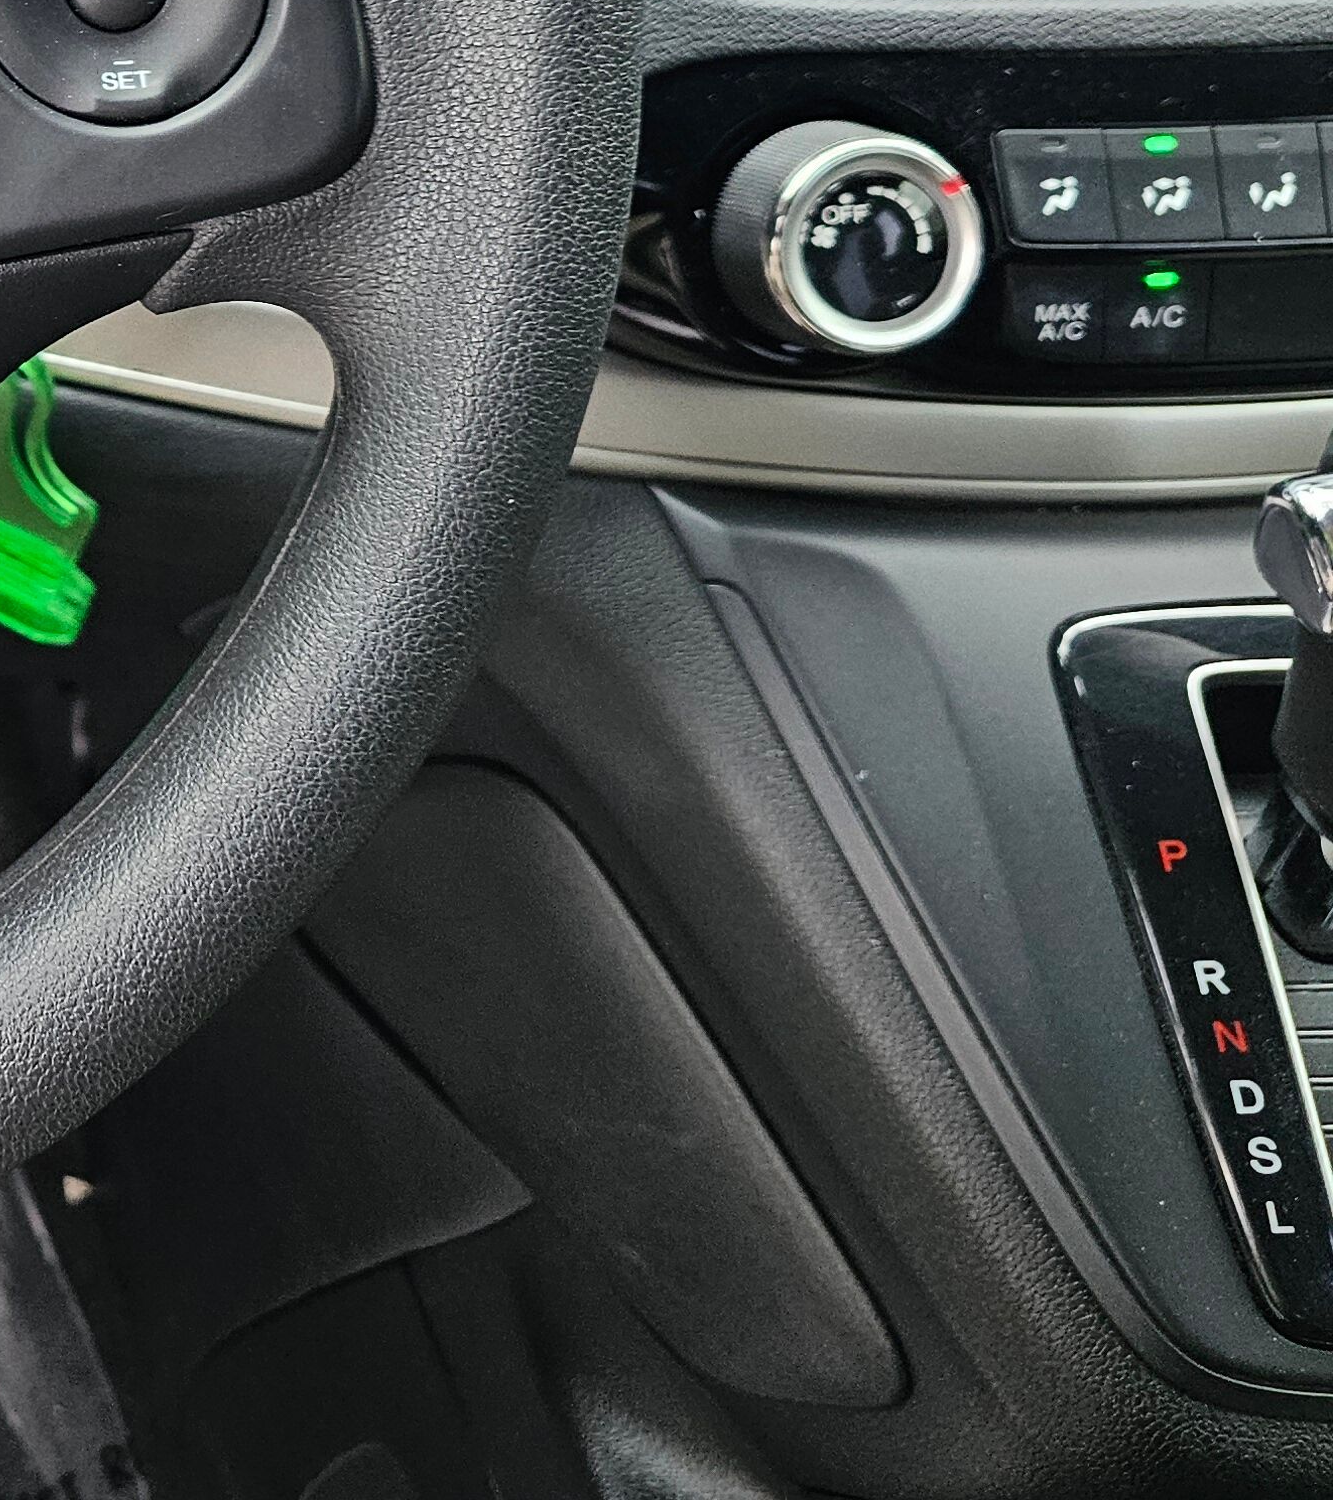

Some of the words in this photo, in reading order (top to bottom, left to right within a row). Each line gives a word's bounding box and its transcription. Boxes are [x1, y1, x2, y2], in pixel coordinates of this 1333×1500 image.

[100, 70, 152, 91] SET
[821, 203, 872, 225] OFF
[1034, 302, 1092, 323] MAX
[1129, 304, 1187, 329] A/C
[1037, 321, 1088, 342] A/C
[1158, 839, 1187, 873] P
[1193, 959, 1230, 996] R
[1212, 1020, 1250, 1054] N
[1229, 1079, 1265, 1115] D
[1248, 1137, 1283, 1175] S
[1265, 1200, 1295, 1235] L
